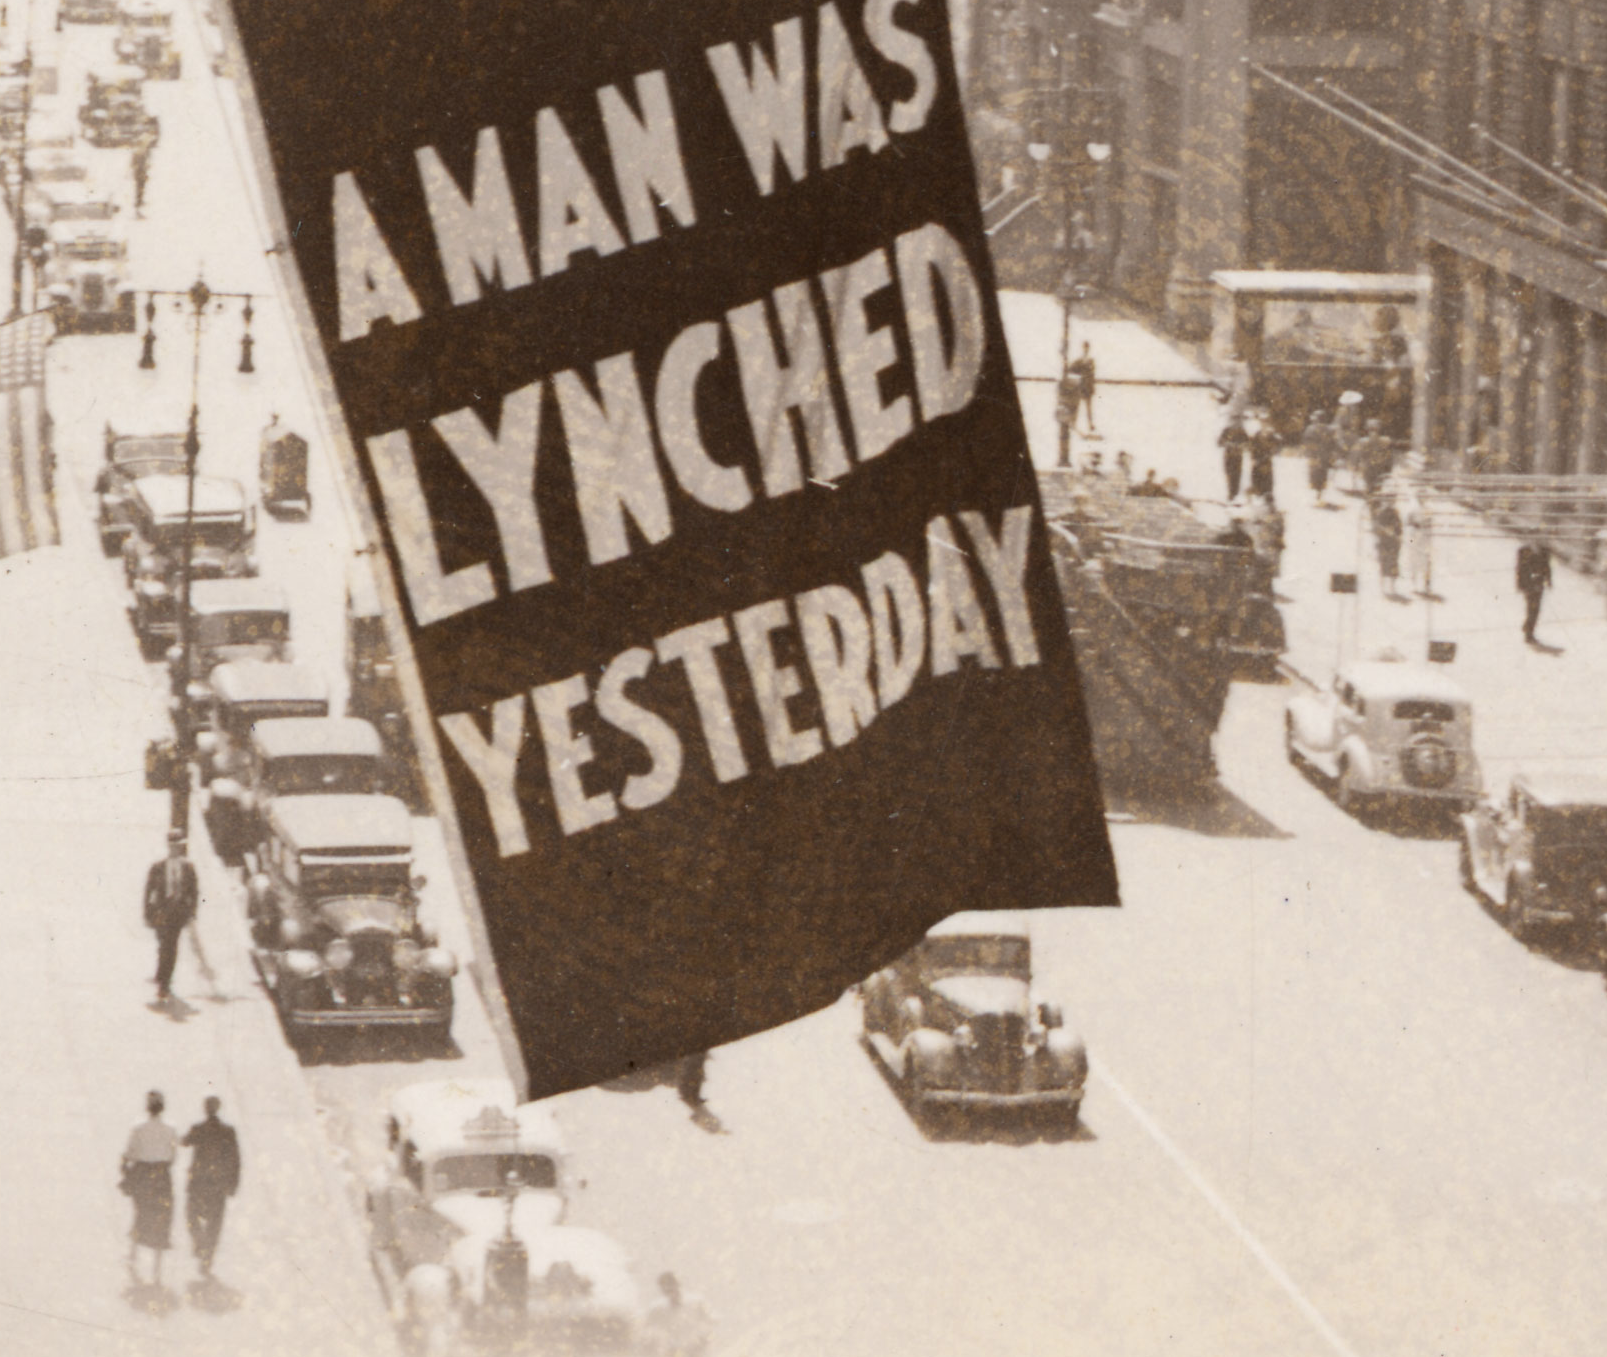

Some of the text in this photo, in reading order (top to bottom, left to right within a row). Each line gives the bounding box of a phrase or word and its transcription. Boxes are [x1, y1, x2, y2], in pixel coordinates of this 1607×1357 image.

[331, 170, 423, 342] A
[414, 69, 697, 307] MAN
[366, 222, 985, 628] LYNCHED
[436, 504, 1041, 860] YESTERDAY
